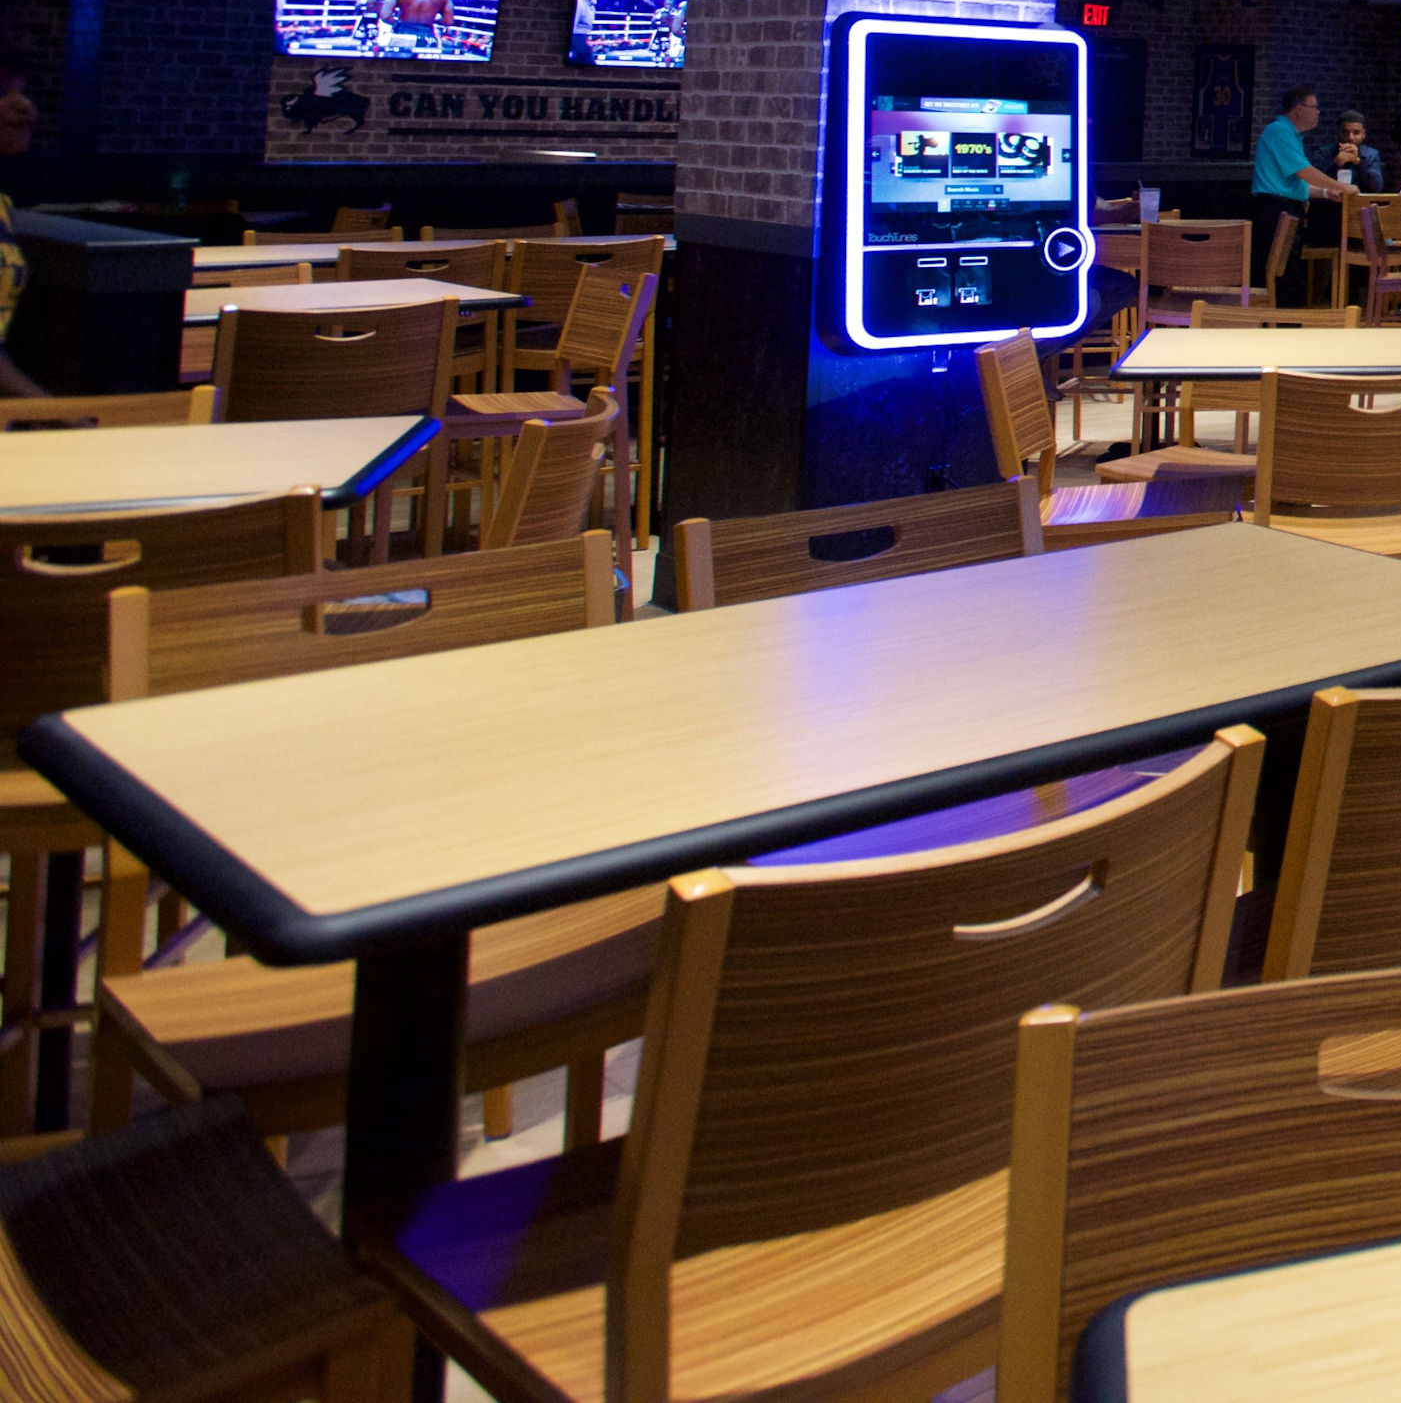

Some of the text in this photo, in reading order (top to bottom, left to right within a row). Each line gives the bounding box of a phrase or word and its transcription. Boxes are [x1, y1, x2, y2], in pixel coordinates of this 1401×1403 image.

[1083, 4, 1110, 26] EXIT
[389, 92, 680, 122] CAN YOU HANDL
[955, 143, 992, 154] 1970's
